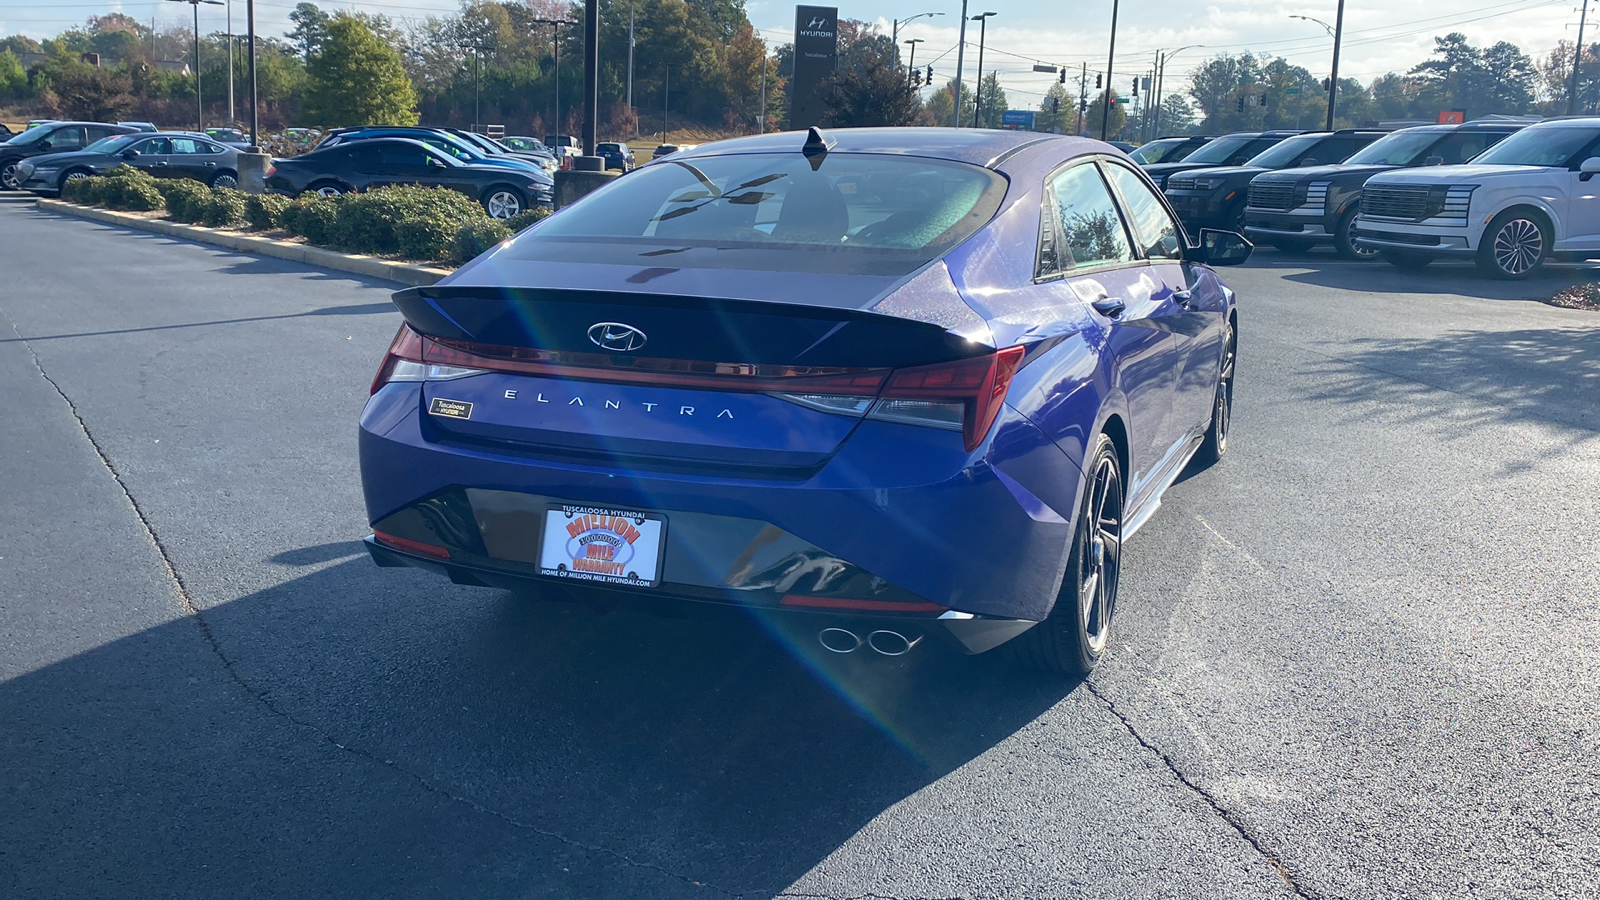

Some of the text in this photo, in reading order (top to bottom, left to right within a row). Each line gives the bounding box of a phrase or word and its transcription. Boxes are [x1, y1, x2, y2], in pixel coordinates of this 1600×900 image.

[800, 30, 833, 38] HYUNDAI
[438, 401, 465, 411] Tuscaloosa
[504, 389, 734, 419] ELANTRA
[563, 505, 645, 519] TUSCALOOSA HYUNDAI
[565, 514, 641, 545] MILLION
[586, 544, 614, 562] MILE
[573, 558, 626, 575] WARRANTY
[608, 577, 650, 587] HYUNDAI.COM
